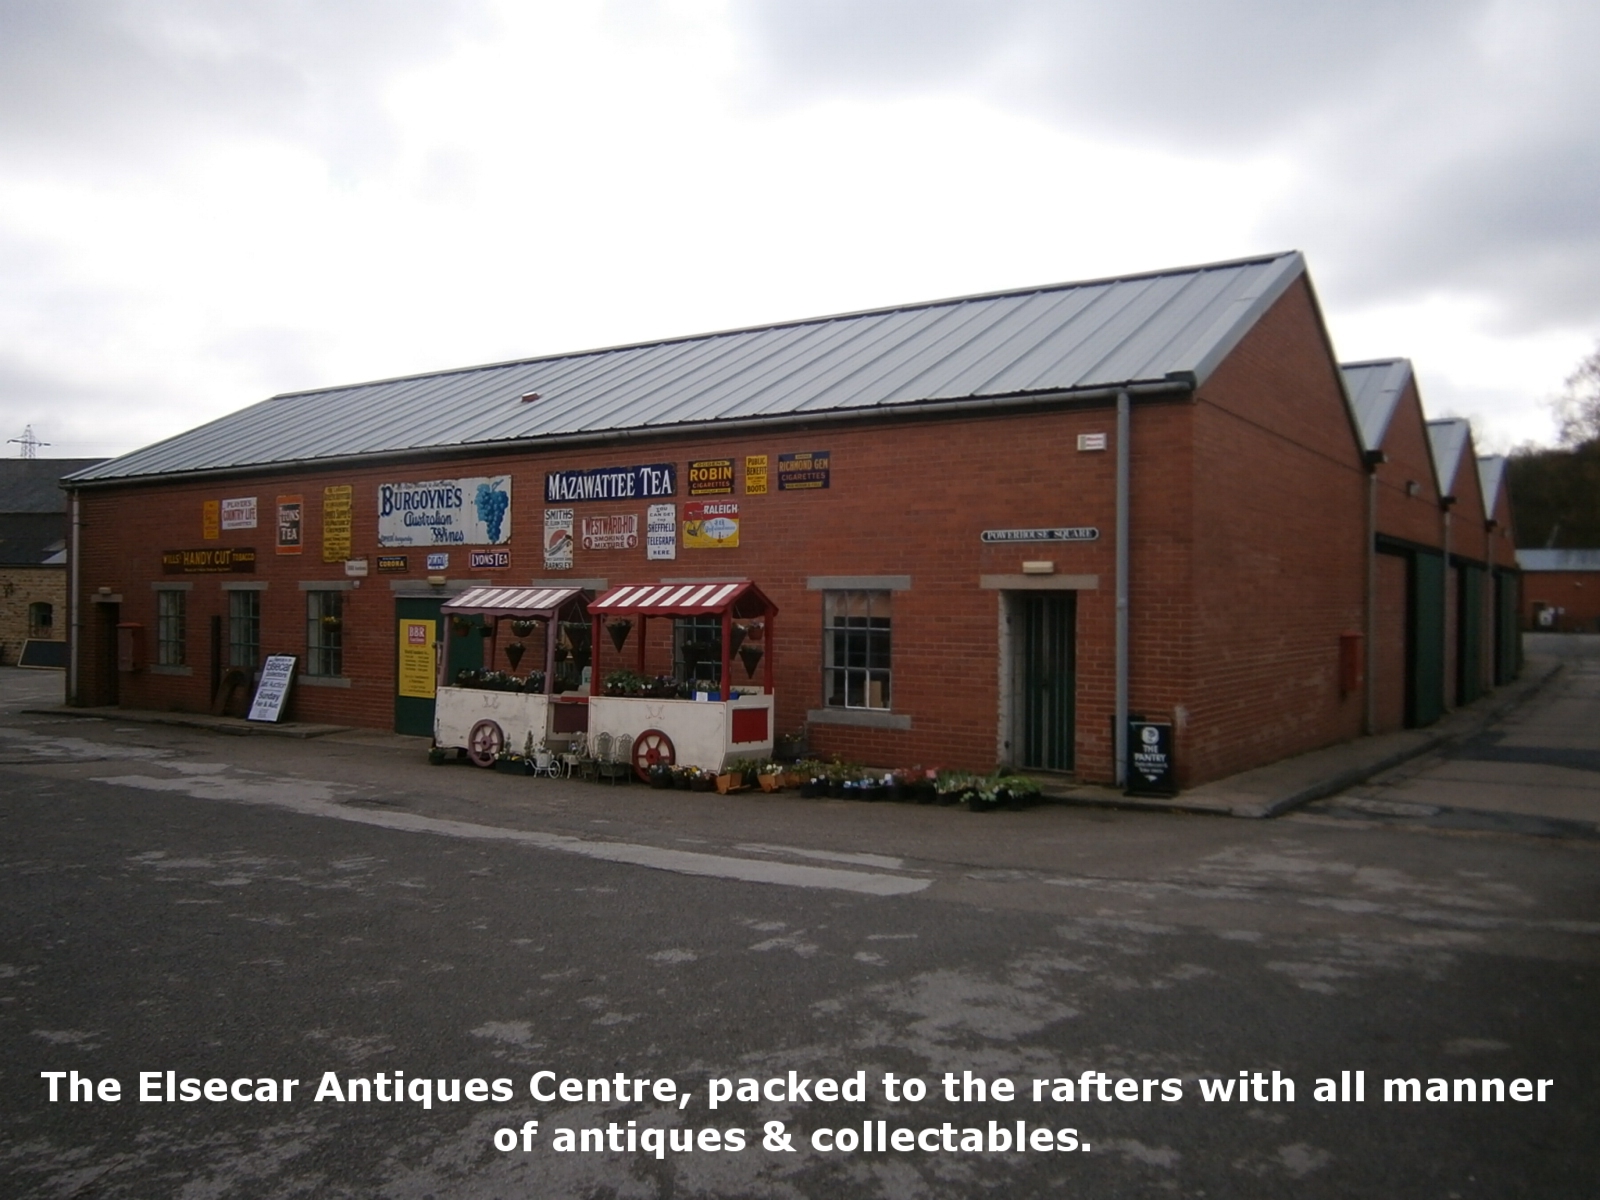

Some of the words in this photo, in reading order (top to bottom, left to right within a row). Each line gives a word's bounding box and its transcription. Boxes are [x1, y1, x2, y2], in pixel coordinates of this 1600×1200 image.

[748, 457, 766, 466] PUBLIC
[779, 460, 812, 472] RICHMOND
[814, 458, 829, 470] GEM
[690, 467, 732, 481] ROBIN
[747, 467, 768, 475] BENEFIT
[782, 472, 826, 482] CIGARETTES
[548, 473, 636, 500] MAZAWATTEE
[640, 467, 673, 496] TEA
[692, 481, 730, 489] CIGARETTES
[747, 485, 766, 493] BOOTS
[380, 485, 463, 517] BURGOYNE'S
[703, 504, 738, 514] RALEIGH
[404, 510, 453, 527] Australian
[545, 510, 573, 520] SMITHS
[648, 522, 675, 532] SHEFFIELD
[281, 528, 298, 540] TEA
[430, 526, 464, 543] Wines
[987, 530, 1050, 540] POWERHOUSE
[1054, 528, 1093, 540] SQUARE
[648, 536, 675, 546] TELEGRAPH
[471, 552, 494, 567] LYONS
[494, 552, 508, 566] TEA
[409, 626, 425, 637] BBR
[258, 691, 280, 702] Sunday
[1142, 744, 1159, 754] THE
[1134, 752, 1166, 762] PANTRY
